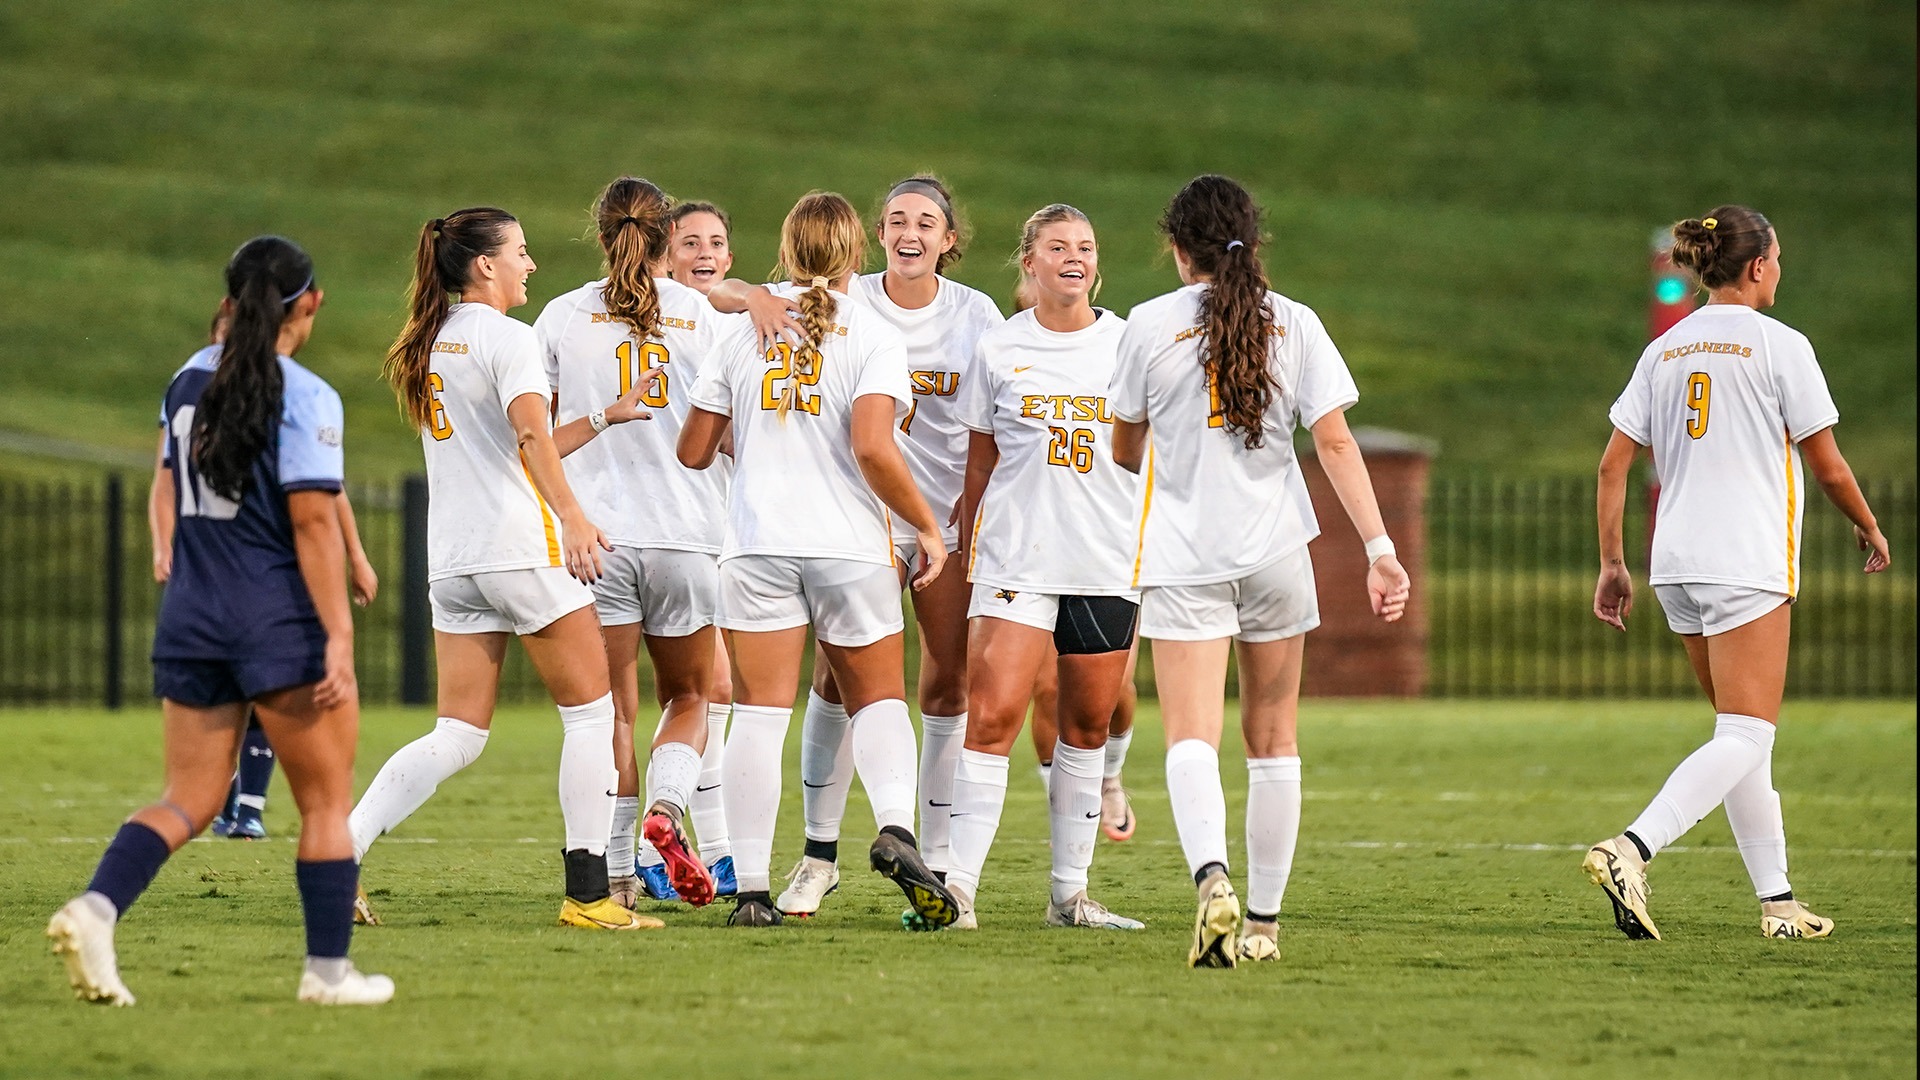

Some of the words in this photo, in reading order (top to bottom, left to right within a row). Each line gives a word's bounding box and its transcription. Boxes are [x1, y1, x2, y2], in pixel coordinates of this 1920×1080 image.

[431, 341, 469, 355] NEERS
[1663, 341, 1752, 362] BUCCANEERS
[616, 341, 670, 408] 16
[761, 341, 824, 416] 22
[908, 369, 961, 396] SU
[428, 372, 454, 441] 6
[1020, 394, 1115, 424] ETSU
[1686, 371, 1712, 440] 9
[1047, 425, 1095, 474] 26
